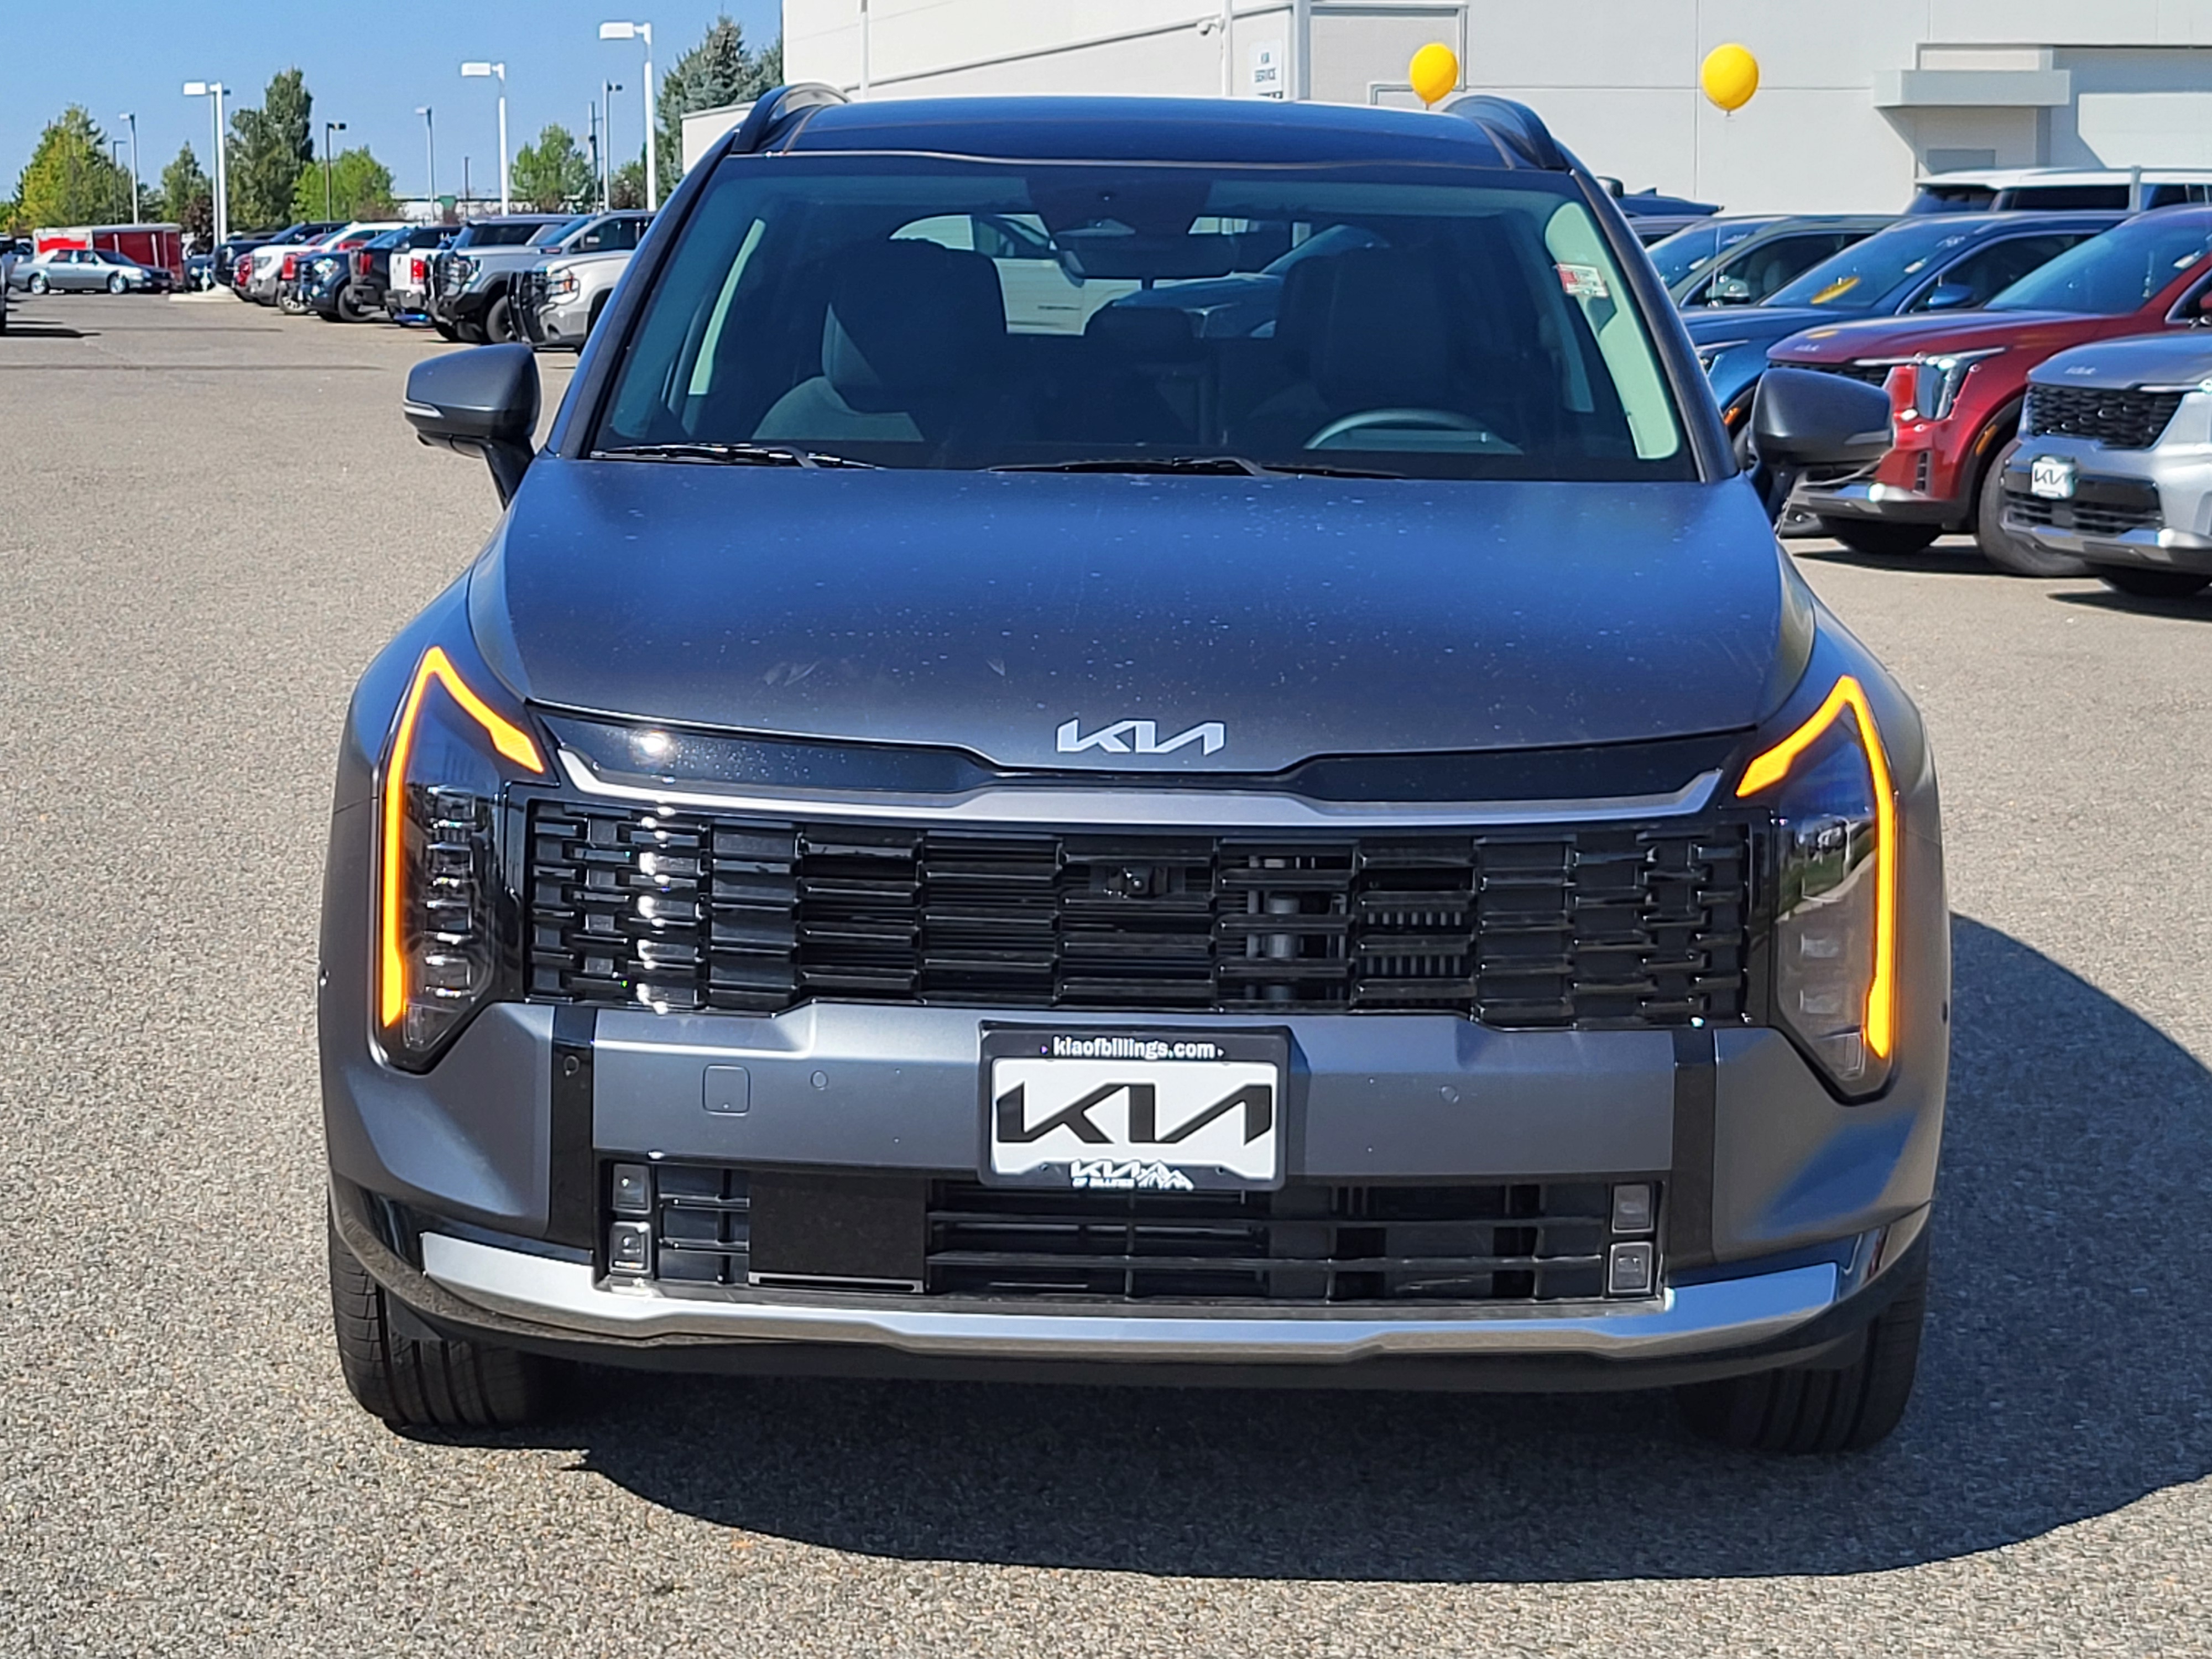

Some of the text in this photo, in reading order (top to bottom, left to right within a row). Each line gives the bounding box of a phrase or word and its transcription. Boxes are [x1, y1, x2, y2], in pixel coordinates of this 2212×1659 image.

[1057, 719, 1225, 755] KIA
[1053, 1037, 1215, 1060] kiaofbillings.com
[997, 1081, 1272, 1146] KIA
[1071, 1160, 1141, 1178] KIA
